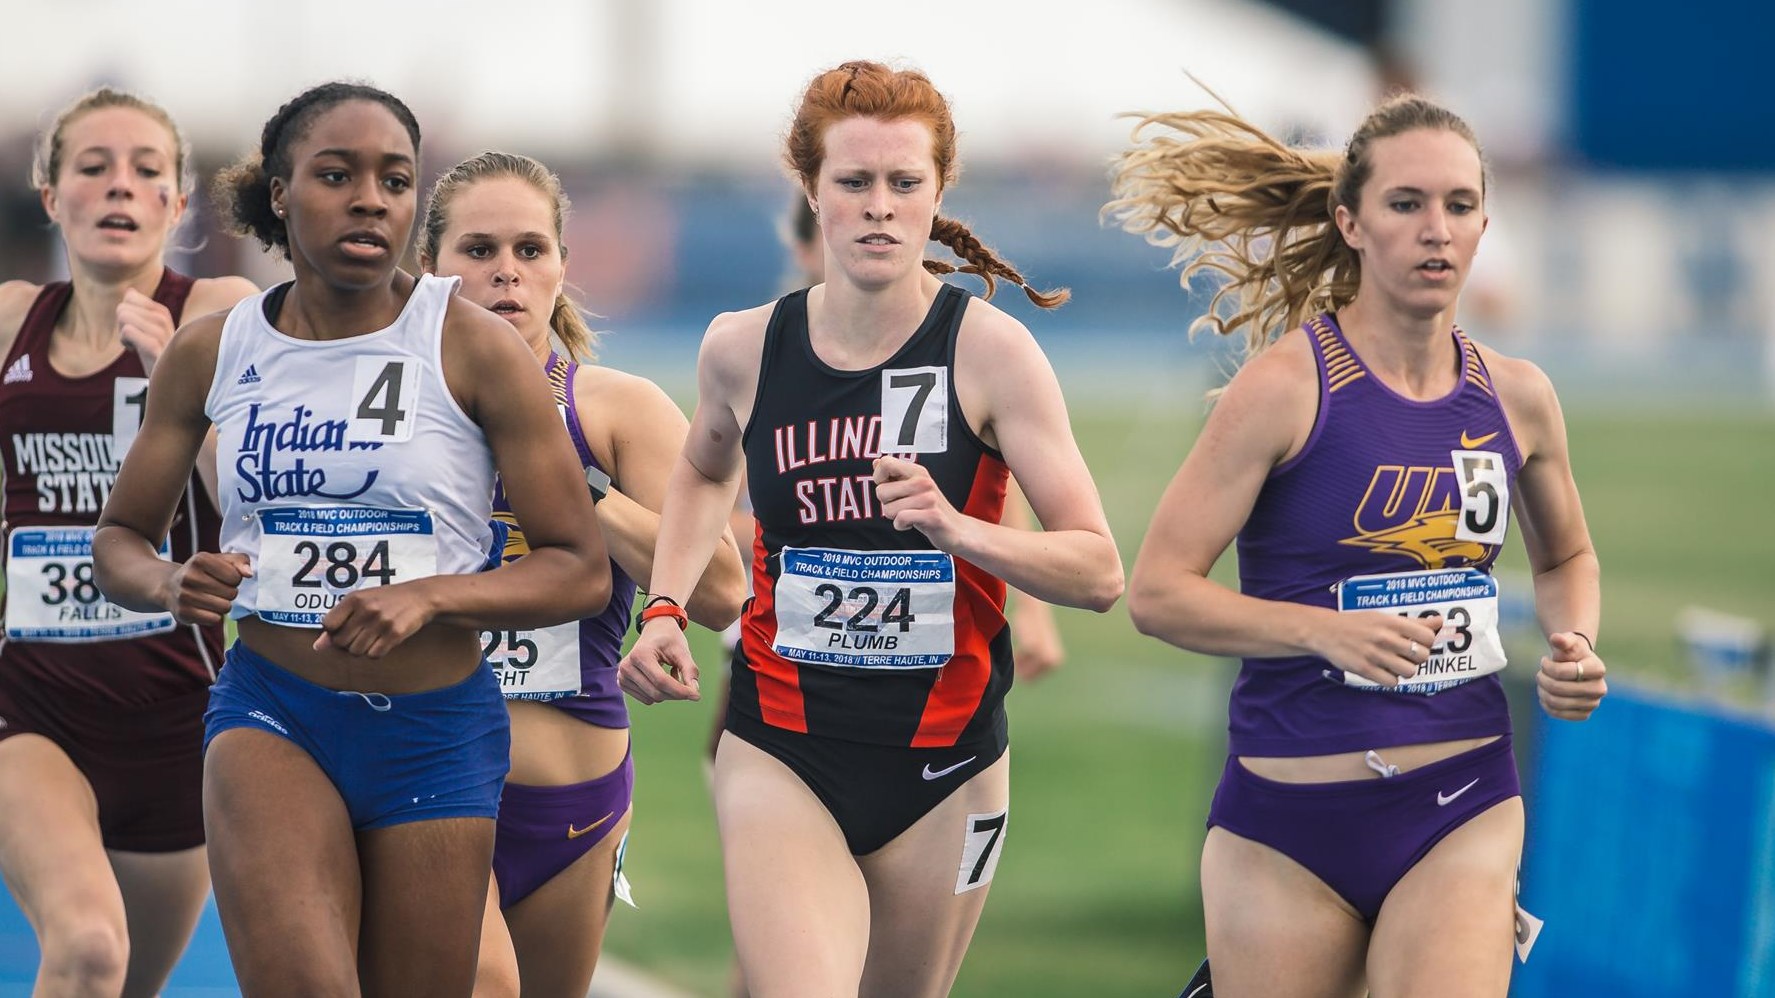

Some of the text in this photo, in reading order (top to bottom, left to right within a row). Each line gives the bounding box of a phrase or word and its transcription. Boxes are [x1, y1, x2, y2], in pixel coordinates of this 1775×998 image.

[356, 362, 404, 435] 4
[890, 372, 936, 446] 7
[12, 433, 120, 475] MISSOU
[236, 452, 379, 503] State
[795, 475, 886, 524] STAT
[1462, 457, 1499, 534] 5
[317, 510, 336, 519] MVC
[339, 509, 388, 519] OUTDOOR
[275, 521, 420, 534] TRACK & FIELD CHAMPIONSHIPS
[292, 540, 396, 588] 284
[795, 562, 941, 580] TRACK & FIELD CHAMPIONSHIPS
[822, 552, 912, 566] 2018 MVC OUTDOOR
[1386, 573, 1466, 591] 2018 MVC OUTDOOR
[1356, 584, 1490, 607] TRACK & FIELD CHAMPIONSHIPS
[59, 605, 122, 622] FALLIS
[272, 612, 289, 621] MAY
[814, 583, 915, 633] 224
[828, 632, 898, 650] PLUMB
[788, 648, 806, 659] MAY
[834, 654, 853, 664] 2018
[854, 655, 861, 664] //
[863, 655, 892, 665] TERRE
[894, 656, 926, 666] HAUTE,
[928, 655, 938, 664] IN
[248, 710, 288, 735] adidas
[967, 812, 1006, 885] 7
